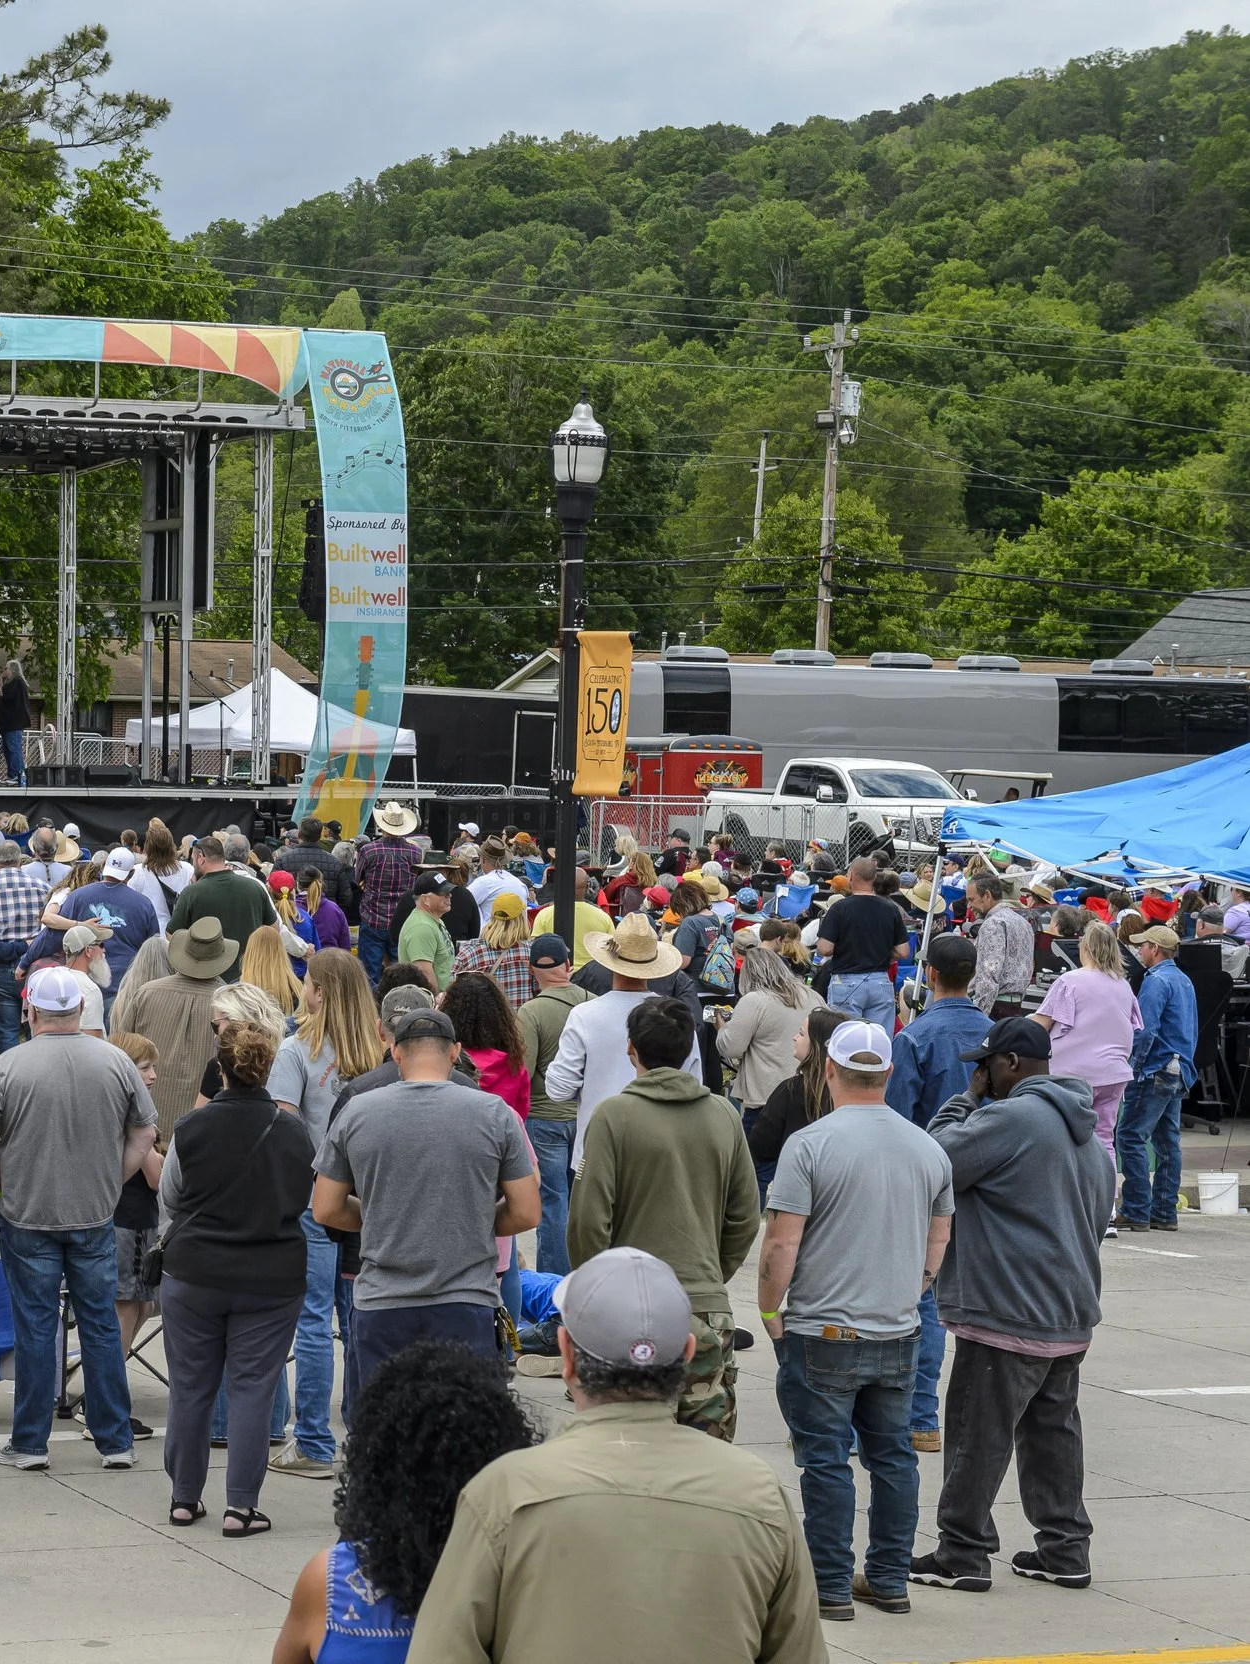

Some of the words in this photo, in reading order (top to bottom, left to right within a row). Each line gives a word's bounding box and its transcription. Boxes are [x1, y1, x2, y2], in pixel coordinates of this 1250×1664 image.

[320, 359, 366, 380] NATIONAL
[319, 413, 338, 427] SOUTH
[340, 423, 372, 432] PITTSBURG
[376, 396, 396, 424] TENNESSEE
[327, 516, 386, 531] Sponsored
[391, 518, 406, 533] By
[328, 543, 405, 563] Builtwell
[375, 566, 405, 576] BANK
[330, 586, 405, 606] Builtwell
[357, 607, 405, 617] INSURANCE
[590, 674, 623, 684] CELEBRATING
[585, 687, 622, 736] 150
[696, 772, 748, 784] LEGACY
